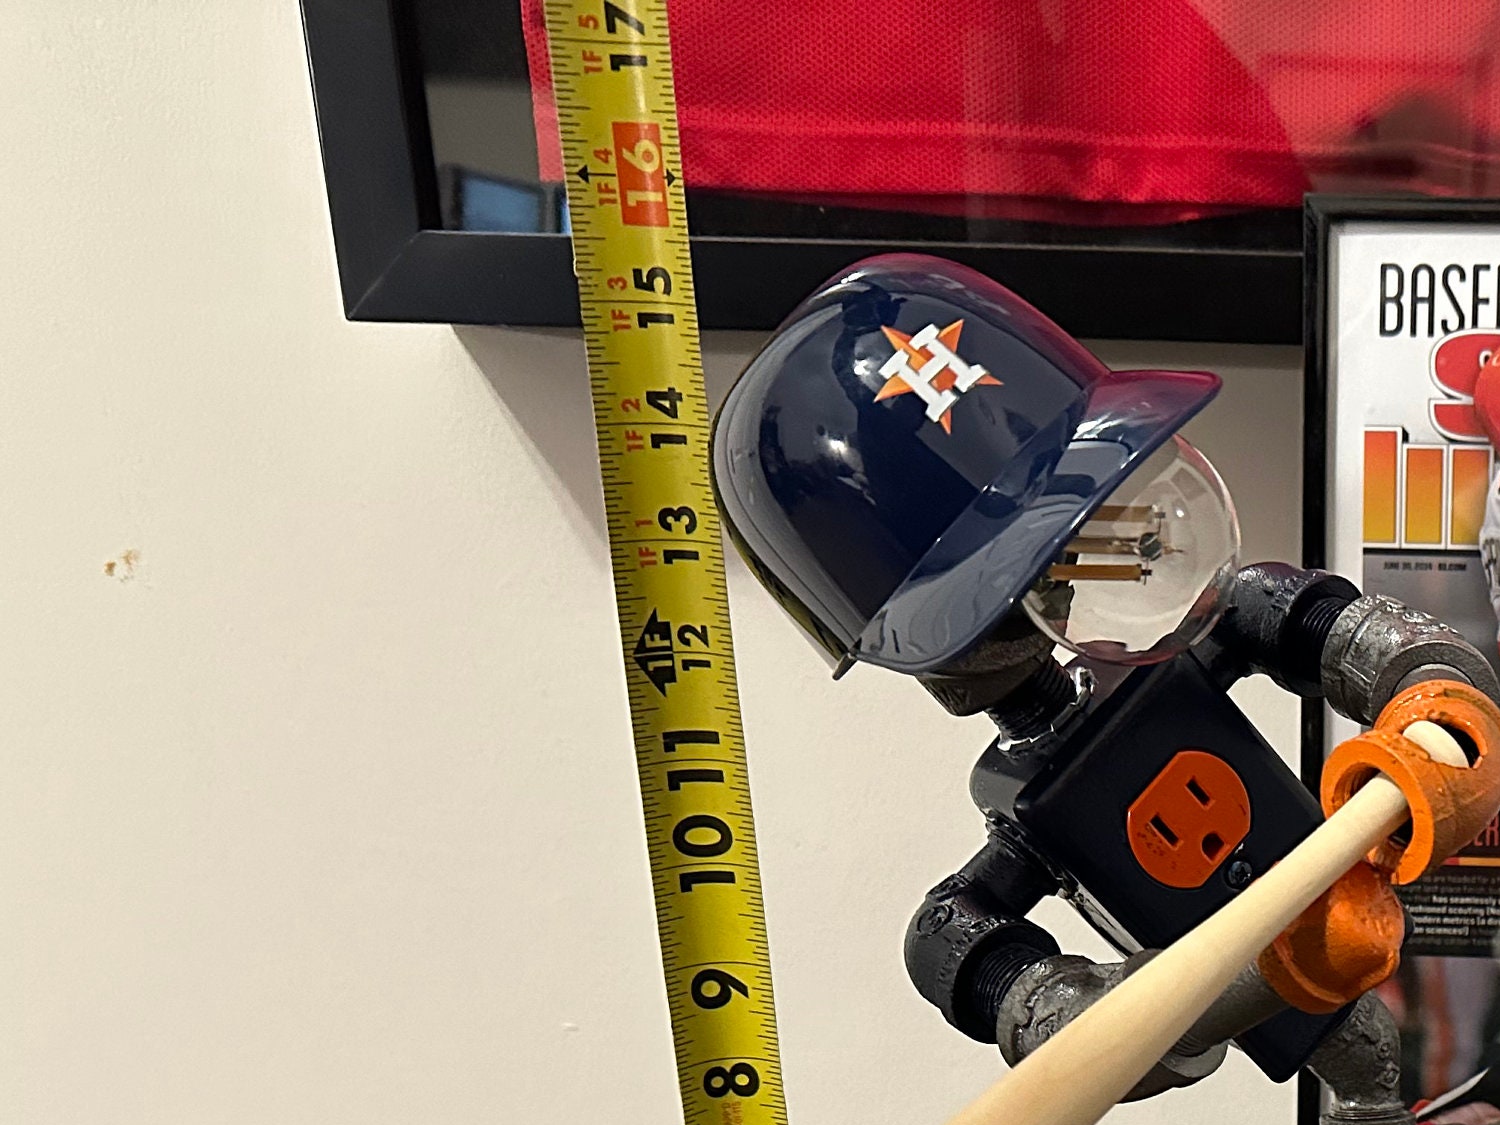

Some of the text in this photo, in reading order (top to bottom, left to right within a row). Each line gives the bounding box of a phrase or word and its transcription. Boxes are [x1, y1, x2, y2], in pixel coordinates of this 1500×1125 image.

[578, 14, 599, 30] 5
[604, 0, 648, 71] 17
[593, 147, 614, 163] 4
[622, 138, 664, 207] 16
[607, 276, 627, 291] 3
[633, 266, 674, 329] 15
[621, 399, 640, 412] 2
[646, 387, 687, 448] 14
[657, 506, 699, 565] 13
[677, 623, 711, 672] 12
[662, 730, 724, 791] 11
[673, 814, 736, 892] 10
[1432, 894, 1448, 904] has
[1449, 896, 1496, 906] seamlessly
[1442, 916, 1475, 925] metrics
[1448, 906, 1485, 917] scouting
[691, 969, 749, 1010] 9
[703, 1062, 760, 1098] 8
